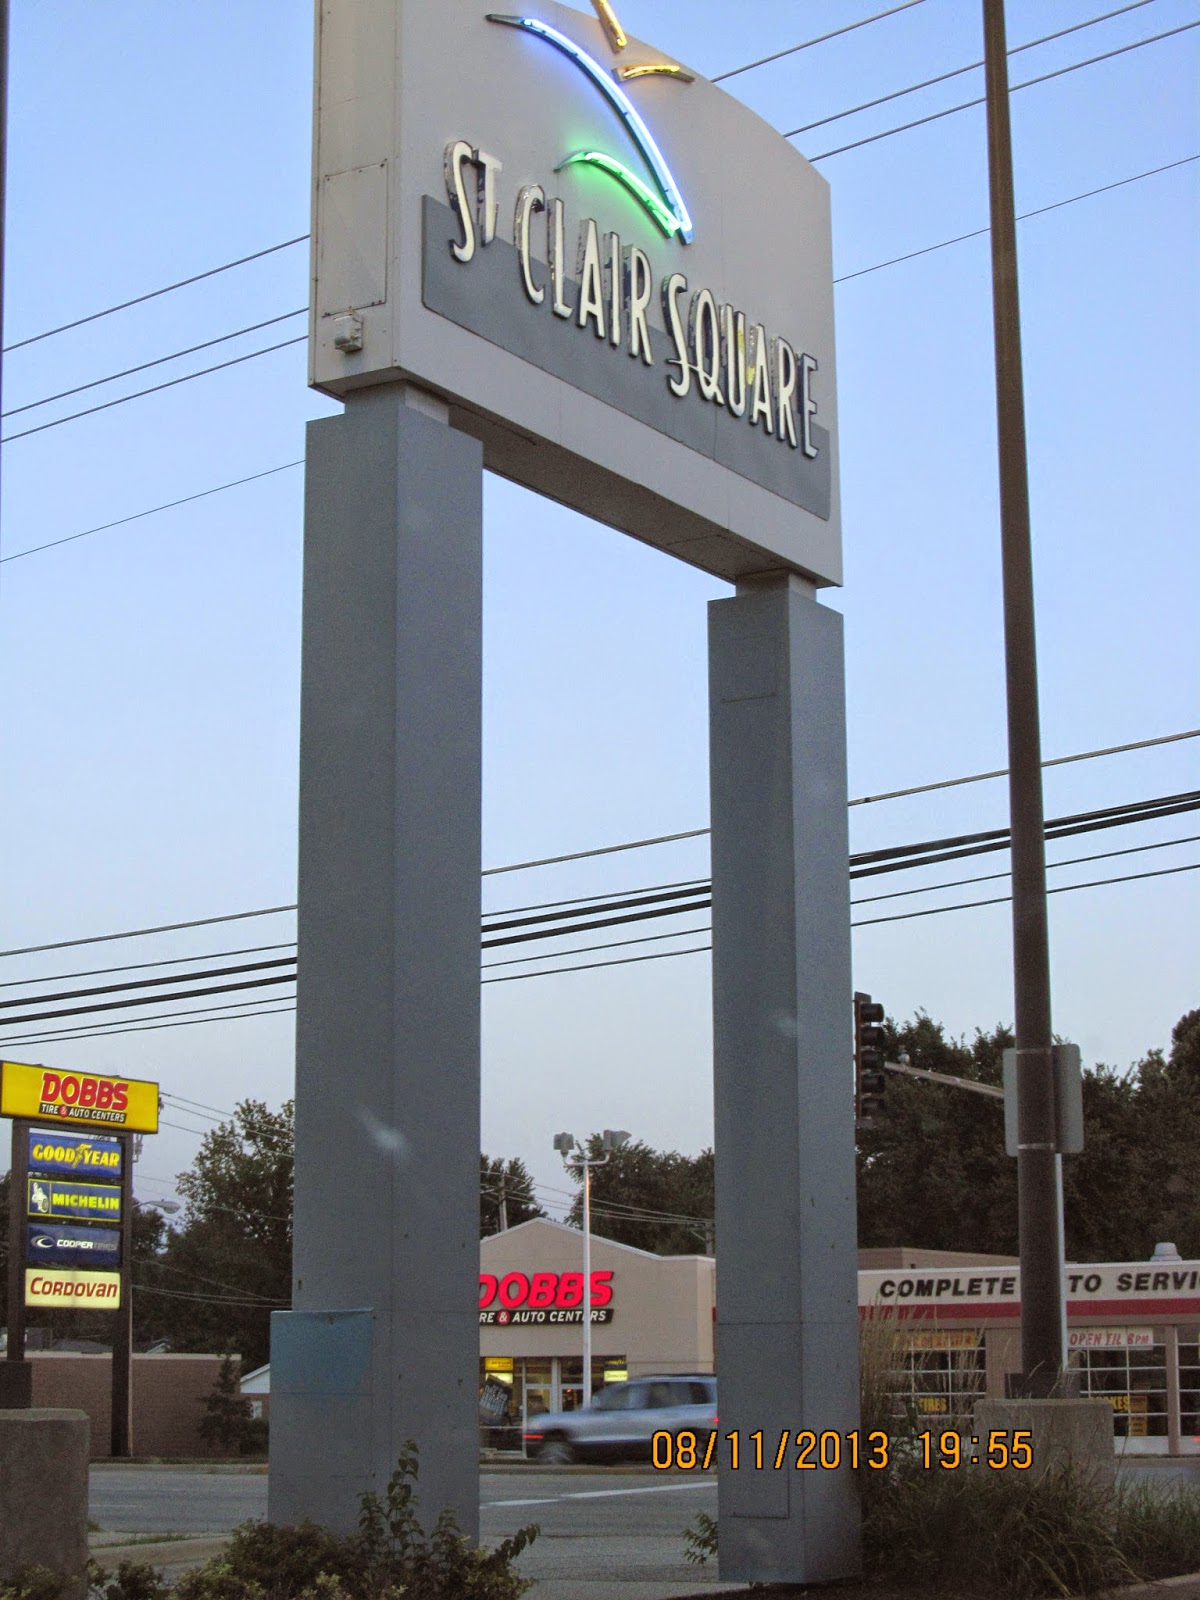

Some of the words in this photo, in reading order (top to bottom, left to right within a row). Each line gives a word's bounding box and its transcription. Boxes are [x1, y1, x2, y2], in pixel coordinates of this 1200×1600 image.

[444, 140, 503, 262] ST
[514, 184, 654, 366] CLAIR
[661, 272, 818, 459] SQUARE
[41, 1072, 128, 1111] DOBBS
[41, 1104, 58, 1114] TIRE
[69, 1107, 90, 1118] AUTO
[91, 1111, 125, 1122] CENTERS
[32, 1143, 120, 1168] GOODYEAR
[52, 1193, 119, 1210] MICHELIN
[479, 1271, 614, 1309] DOBBS
[880, 1276, 1016, 1298] COMPLETE
[1116, 1271, 1200, 1292] SERVI
[479, 1311, 495, 1323] RE
[498, 1311, 508, 1323] &
[511, 1311, 546, 1323] AUTO
[549, 1310, 607, 1323] CENTRS
[1069, 1332, 1101, 1346] OPEN
